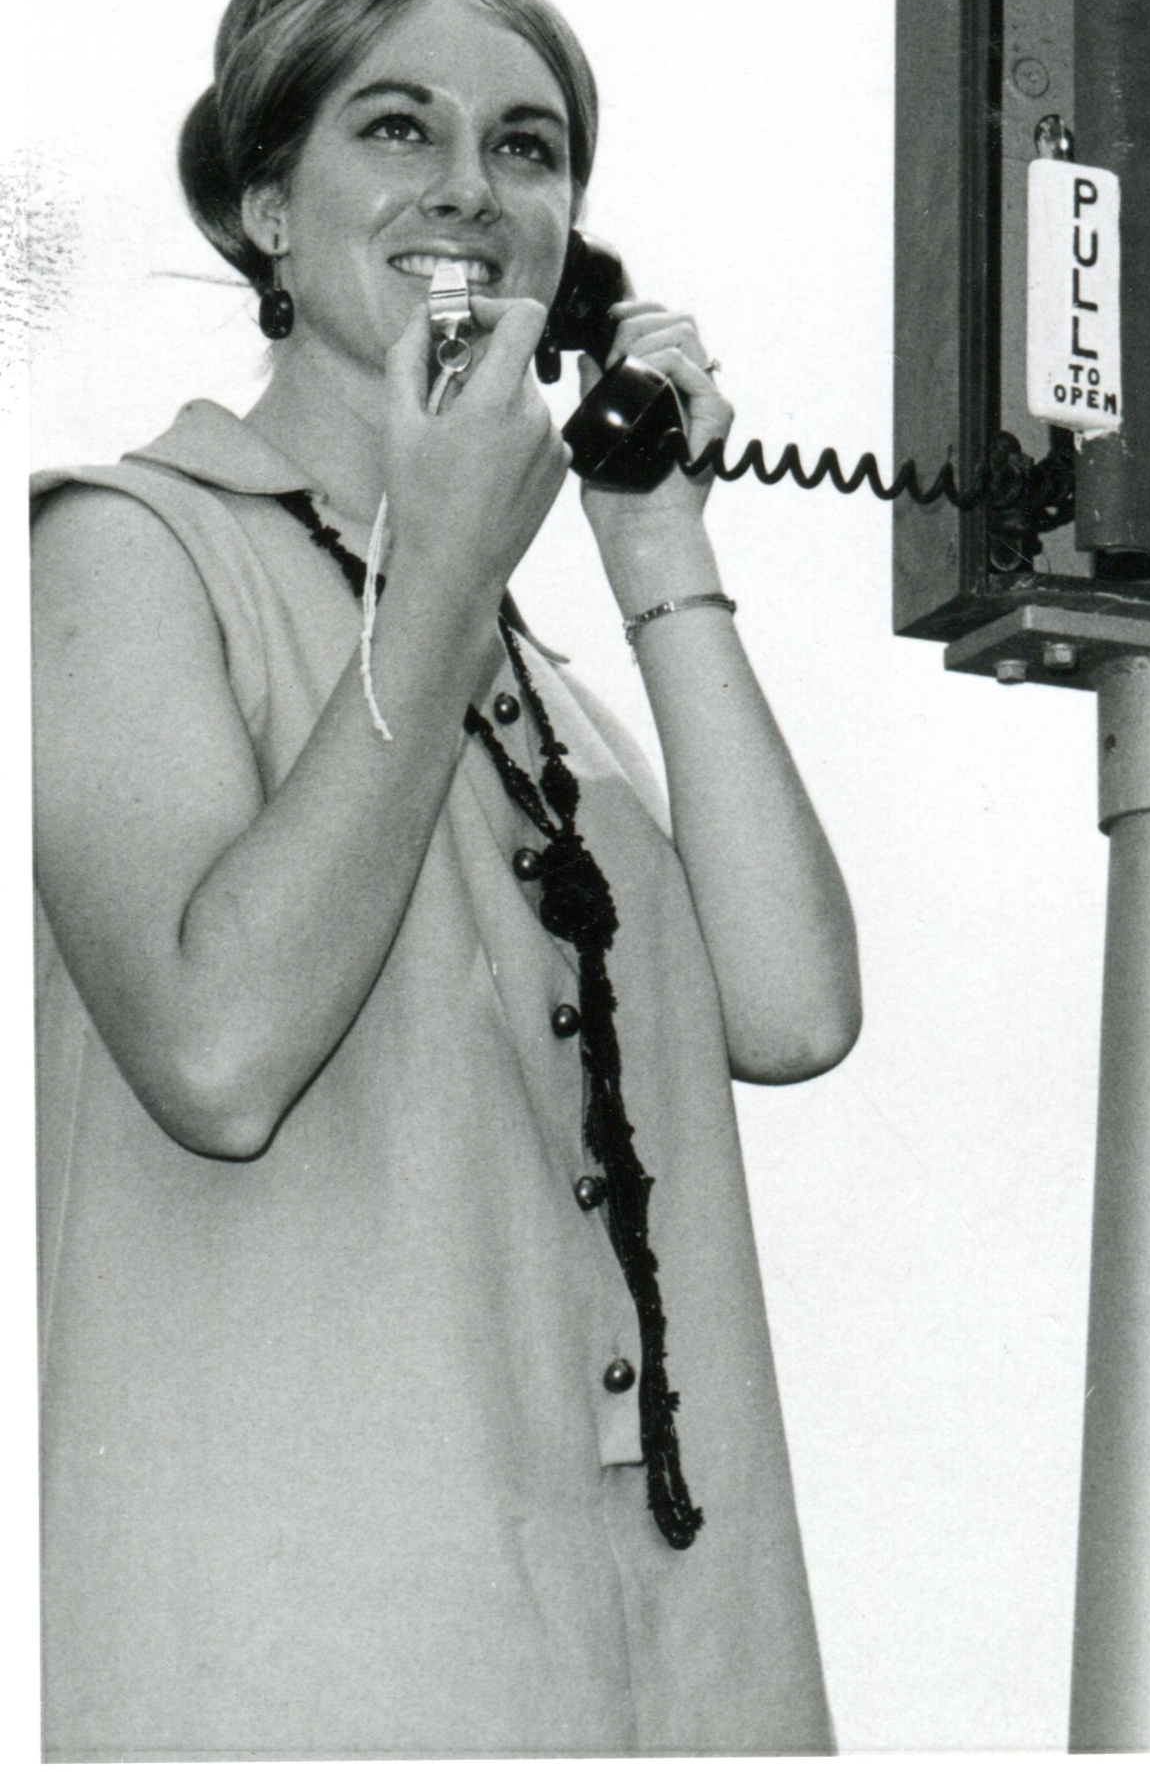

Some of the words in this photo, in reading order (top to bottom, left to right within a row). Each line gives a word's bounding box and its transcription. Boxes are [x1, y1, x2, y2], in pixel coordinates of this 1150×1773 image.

[1072, 178, 1099, 360] PULL
[1068, 364, 1100, 386] TO
[1054, 384, 1117, 415] OPEN
